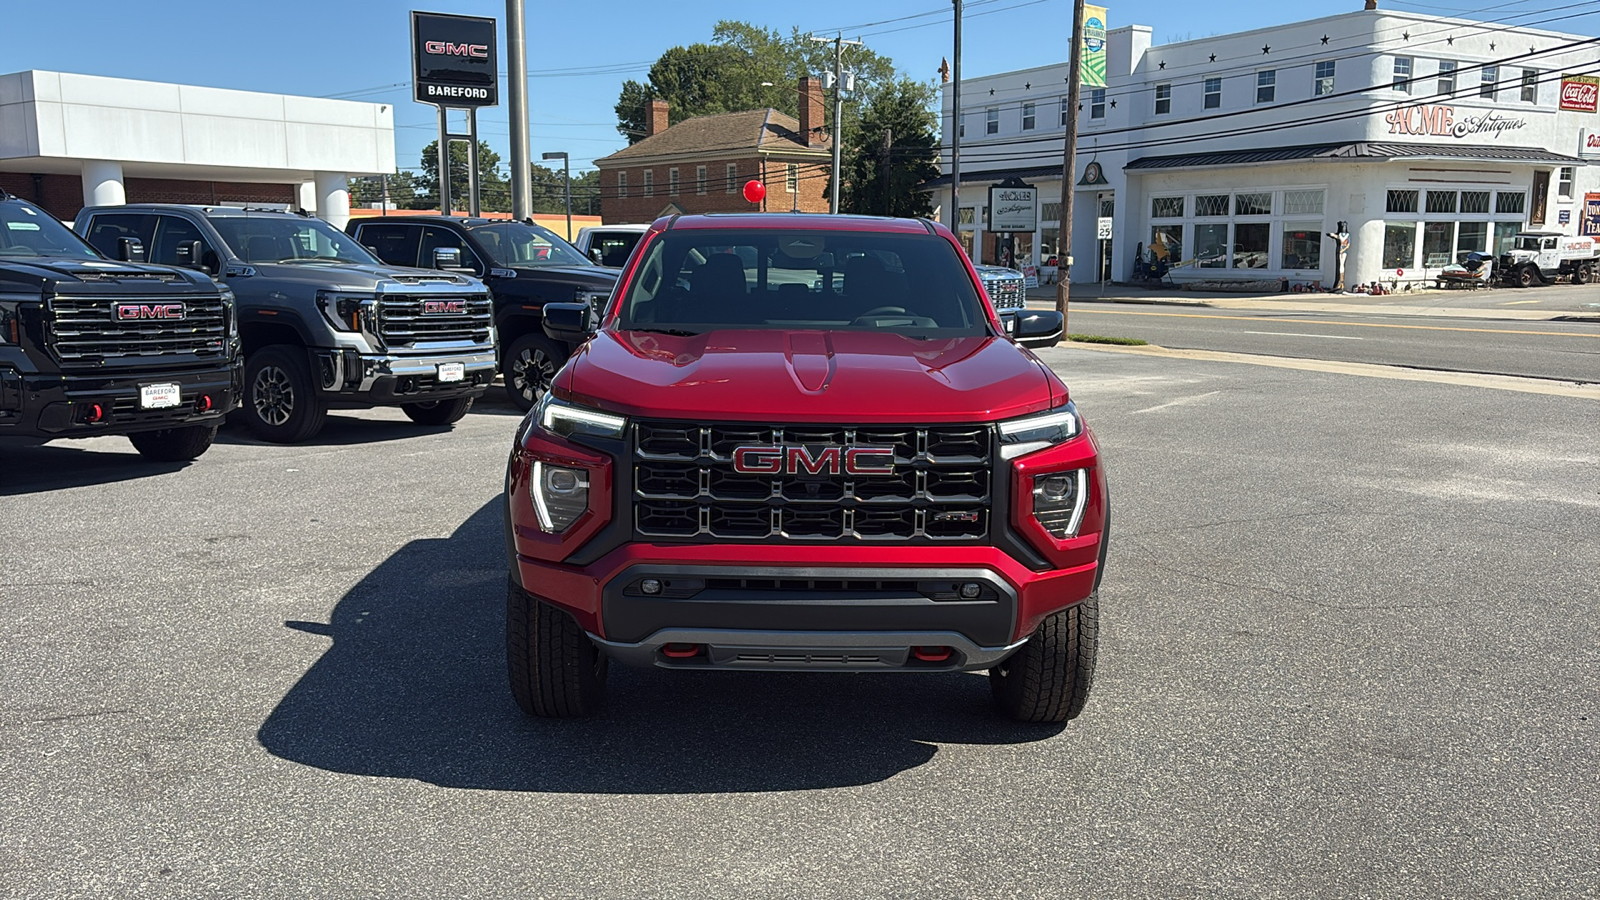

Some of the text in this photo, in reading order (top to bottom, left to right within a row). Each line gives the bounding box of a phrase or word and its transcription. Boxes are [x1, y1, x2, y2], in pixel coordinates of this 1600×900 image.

[425, 40, 488, 58] GMC
[428, 85, 488, 99] BAREFORD
[1385, 104, 1455, 136] ACME
[998, 190, 1031, 202] ACME
[1099, 228, 1111, 237] 25
[118, 305, 183, 319] GMC
[425, 301, 467, 313] GMC
[145, 388, 176, 396] BAREFORD
[733, 445, 895, 476] GMC
[933, 511, 979, 522] AT4
